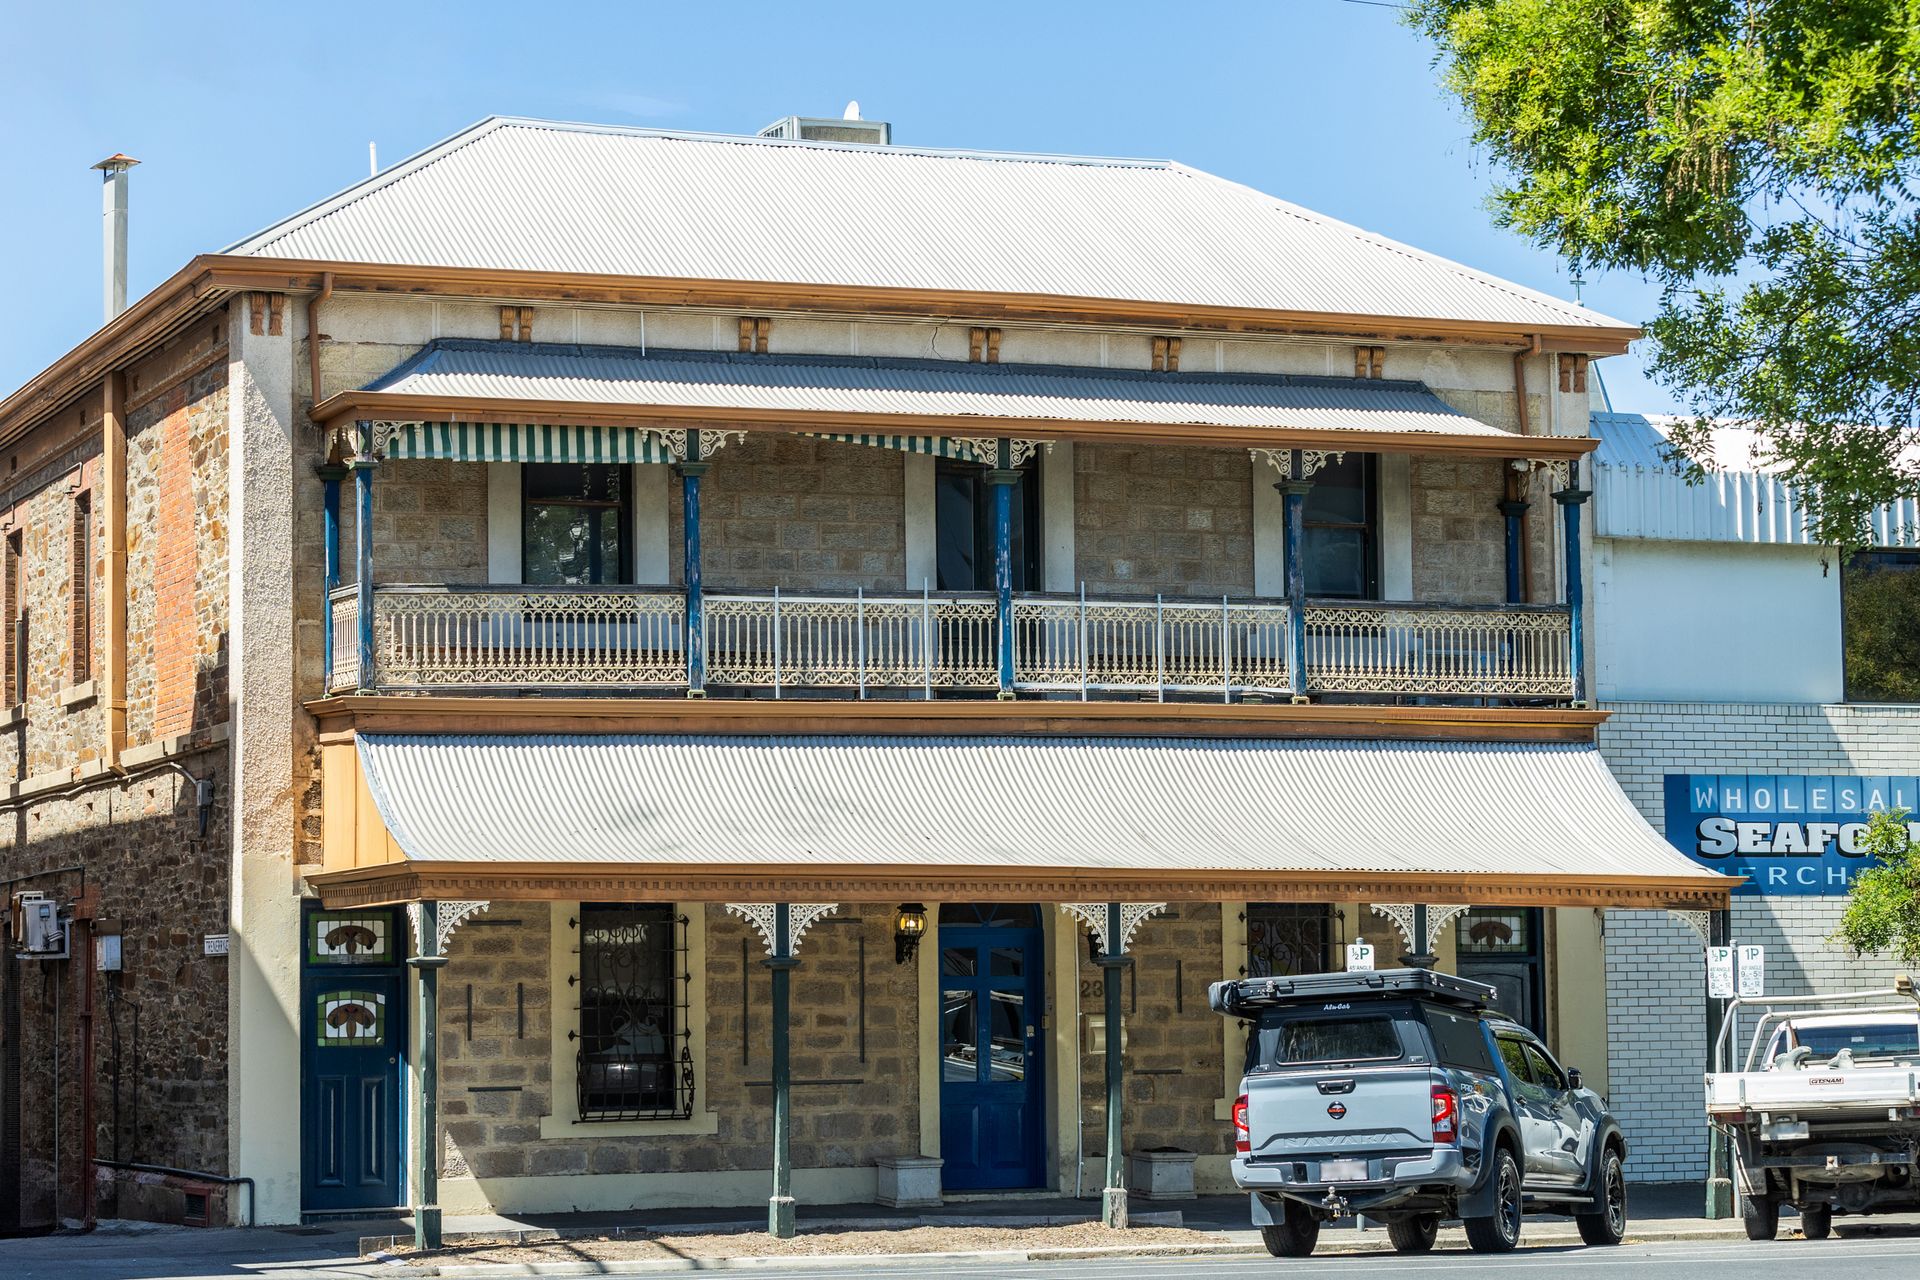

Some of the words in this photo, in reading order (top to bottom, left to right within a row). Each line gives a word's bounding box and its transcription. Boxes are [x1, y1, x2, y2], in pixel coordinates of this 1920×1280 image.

[1695, 786, 1912, 811] WHOLESAL
[1696, 817, 1920, 858] SEAFO
[1080, 980, 1104, 998] 23
[1283, 1133, 1399, 1148] NAVARA
